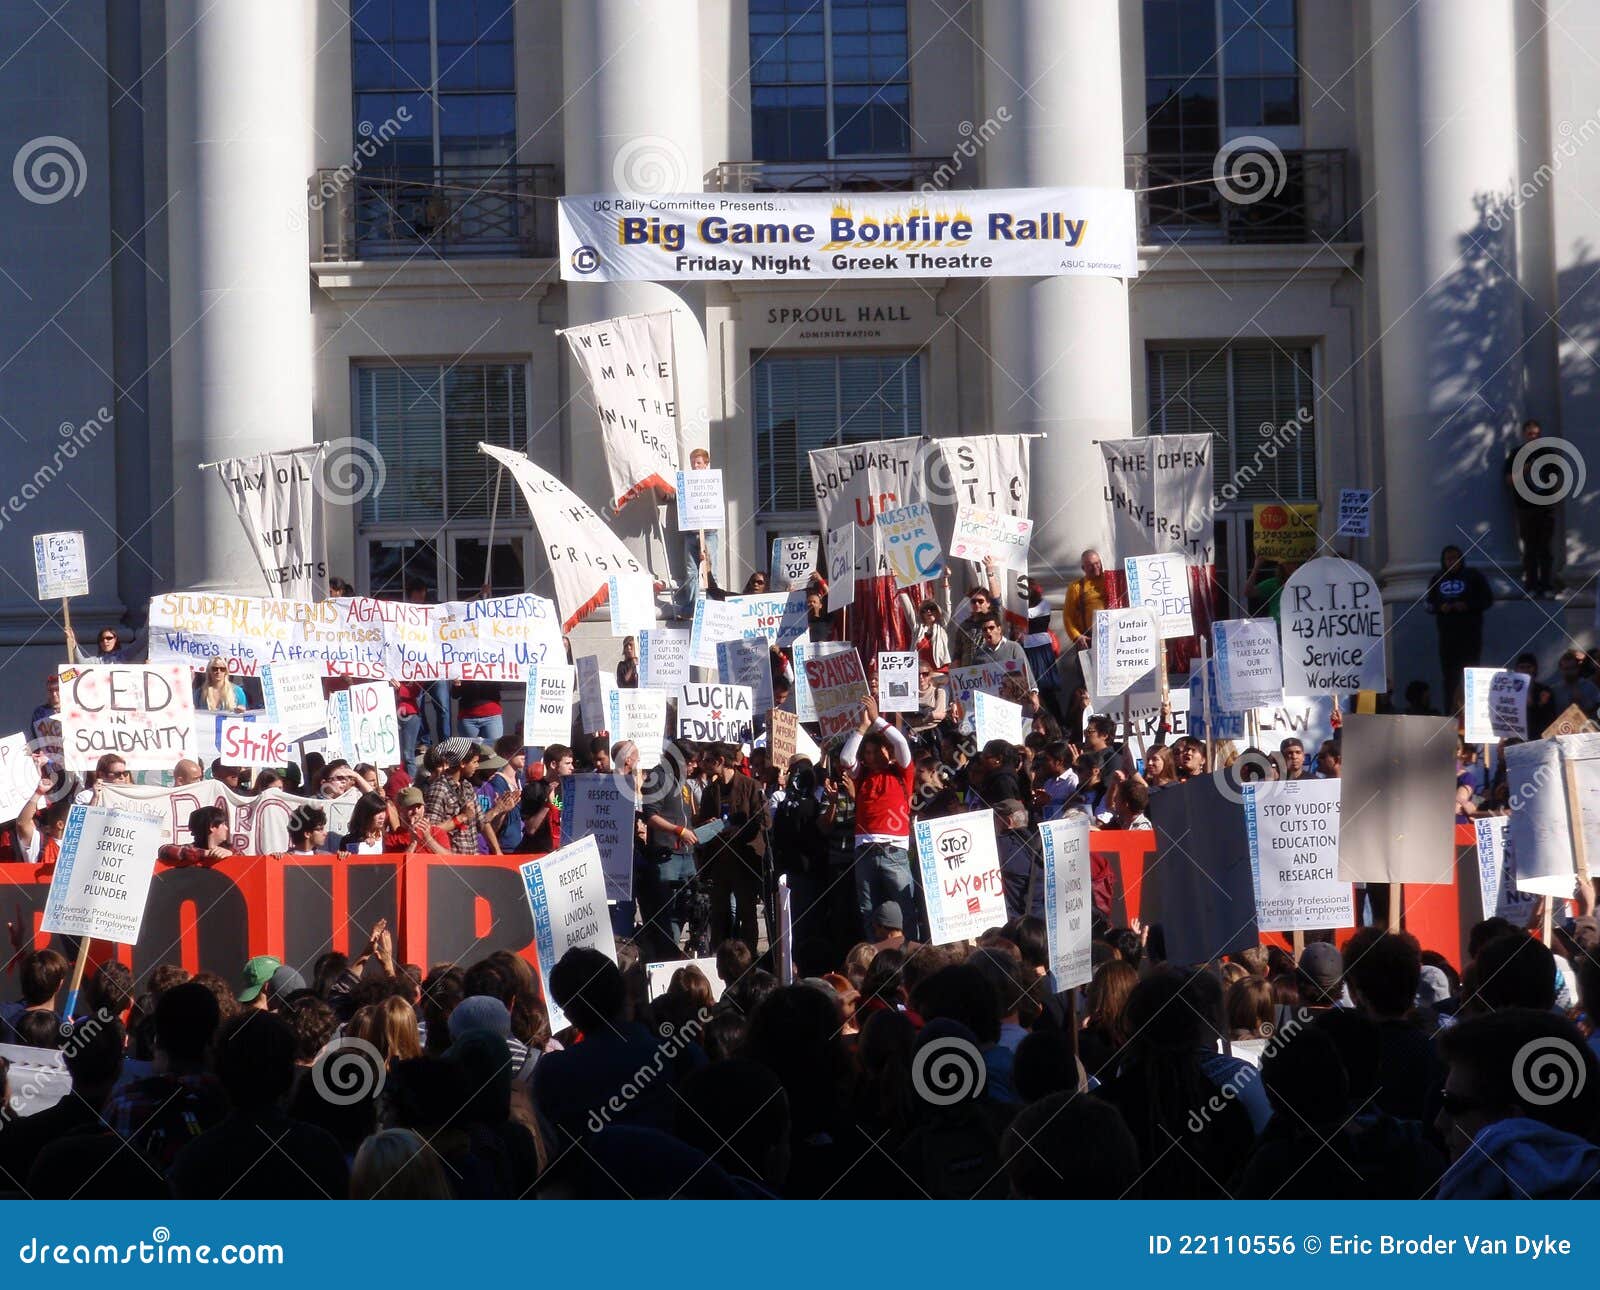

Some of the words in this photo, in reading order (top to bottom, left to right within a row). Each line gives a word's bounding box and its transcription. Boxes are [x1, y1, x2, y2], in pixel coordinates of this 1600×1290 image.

[594, 200, 610, 212] UC
[615, 200, 647, 212] Rally
[650, 199, 715, 211] Committee
[720, 199, 786, 212] Presents...
[620, 216, 686, 251] Big
[698, 216, 815, 244] Game
[829, 214, 974, 243] Bonfire
[988, 212, 1089, 248] Rally
[676, 255, 743, 274] Friday
[751, 255, 811, 274] Night
[832, 253, 898, 270] Greek
[906, 252, 993, 269] Theatre
[1060, 259, 1085, 269] ASUC
[767, 307, 846, 324] SPROUL
[858, 306, 911, 322] HALL
[579, 332, 611, 349] WE
[799, 330, 881, 339] ADMINISTRATION
[637, 398, 677, 418] THE
[1107, 454, 1146, 473] THE
[1157, 450, 1207, 470] OPEN
[231, 473, 266, 494] TAX
[276, 465, 310, 484] OIL
[876, 503, 930, 526] NUESTRA
[1103, 485, 1212, 563] UNIVERSITY
[261, 527, 294, 547] NOT
[889, 528, 927, 544] OUR
[549, 543, 639, 573] CRISIS
[790, 551, 808, 561] OR
[889, 542, 943, 584] UC
[785, 562, 810, 572] YUD
[788, 570, 804, 579] OF
[1148, 560, 1169, 581] SI
[1151, 580, 1173, 596] SE
[1290, 580, 1371, 613] R.I.P.
[346, 597, 434, 627] AGAINST
[463, 595, 547, 623] INCREASES
[757, 615, 784, 628] NOT
[1118, 620, 1148, 630] Unfair
[1291, 617, 1315, 639] 43
[1316, 611, 1382, 639] AFSCME
[438, 623, 480, 641] Can't
[1119, 634, 1147, 644] Labor
[166, 632, 220, 657] Where's
[229, 643, 255, 658] the
[397, 643, 428, 663] You
[441, 642, 505, 664] Promised
[515, 643, 548, 665] Us?
[1258, 638, 1272, 646] CAN
[1116, 647, 1149, 655] Practice
[1236, 649, 1252, 657] TAKE
[1253, 648, 1270, 656] BACK
[1302, 644, 1363, 667] Service
[326, 660, 385, 679] KIDS
[1116, 658, 1149, 668] STRIKE
[1246, 658, 1261, 667] OUR
[1237, 668, 1273, 677] UNIVERSITY
[1306, 672, 1361, 690] Workers
[72, 668, 173, 713] CED
[540, 678, 566, 690] FULL
[353, 686, 380, 715] NO
[683, 685, 750, 711] LUCHA
[539, 704, 564, 715] NOW
[75, 726, 191, 754] SOLIDARITY
[225, 725, 289, 764] Strike
[587, 790, 619, 800] RESPECT
[595, 804, 611, 816] THE
[1263, 804, 1292, 817] STOP
[1294, 802, 1341, 816] YUDOF'S
[102, 825, 136, 841] PUBLIC
[1280, 820, 1308, 832] CUTS
[1311, 819, 1326, 830] TO
[96, 840, 135, 857] SERVICE,
[940, 836, 968, 853] STOP
[1272, 836, 1336, 849] EDUCATION
[101, 856, 123, 868] NOT
[944, 854, 967, 871] THE
[1293, 853, 1318, 865] AND
[92, 870, 126, 886] PUBLIC
[558, 862, 588, 888] RESPECT
[944, 868, 1005, 898] LAYOFFS
[1279, 868, 1334, 882] RESEARCH
[83, 884, 128, 900] PLUNDER
[568, 886, 585, 903] THE
[1256, 898, 1295, 908] niversity
[1298, 894, 1350, 906] Professional
[54, 903, 92, 916] University
[92, 908, 139, 923] Professional
[564, 902, 595, 926] UNIONS,
[1262, 906, 1302, 917] Technical
[1304, 904, 1350, 916] Employees
[60, 912, 94, 924] Technical
[94, 917, 136, 932] Employees
[566, 921, 599, 947] BARGAIN
